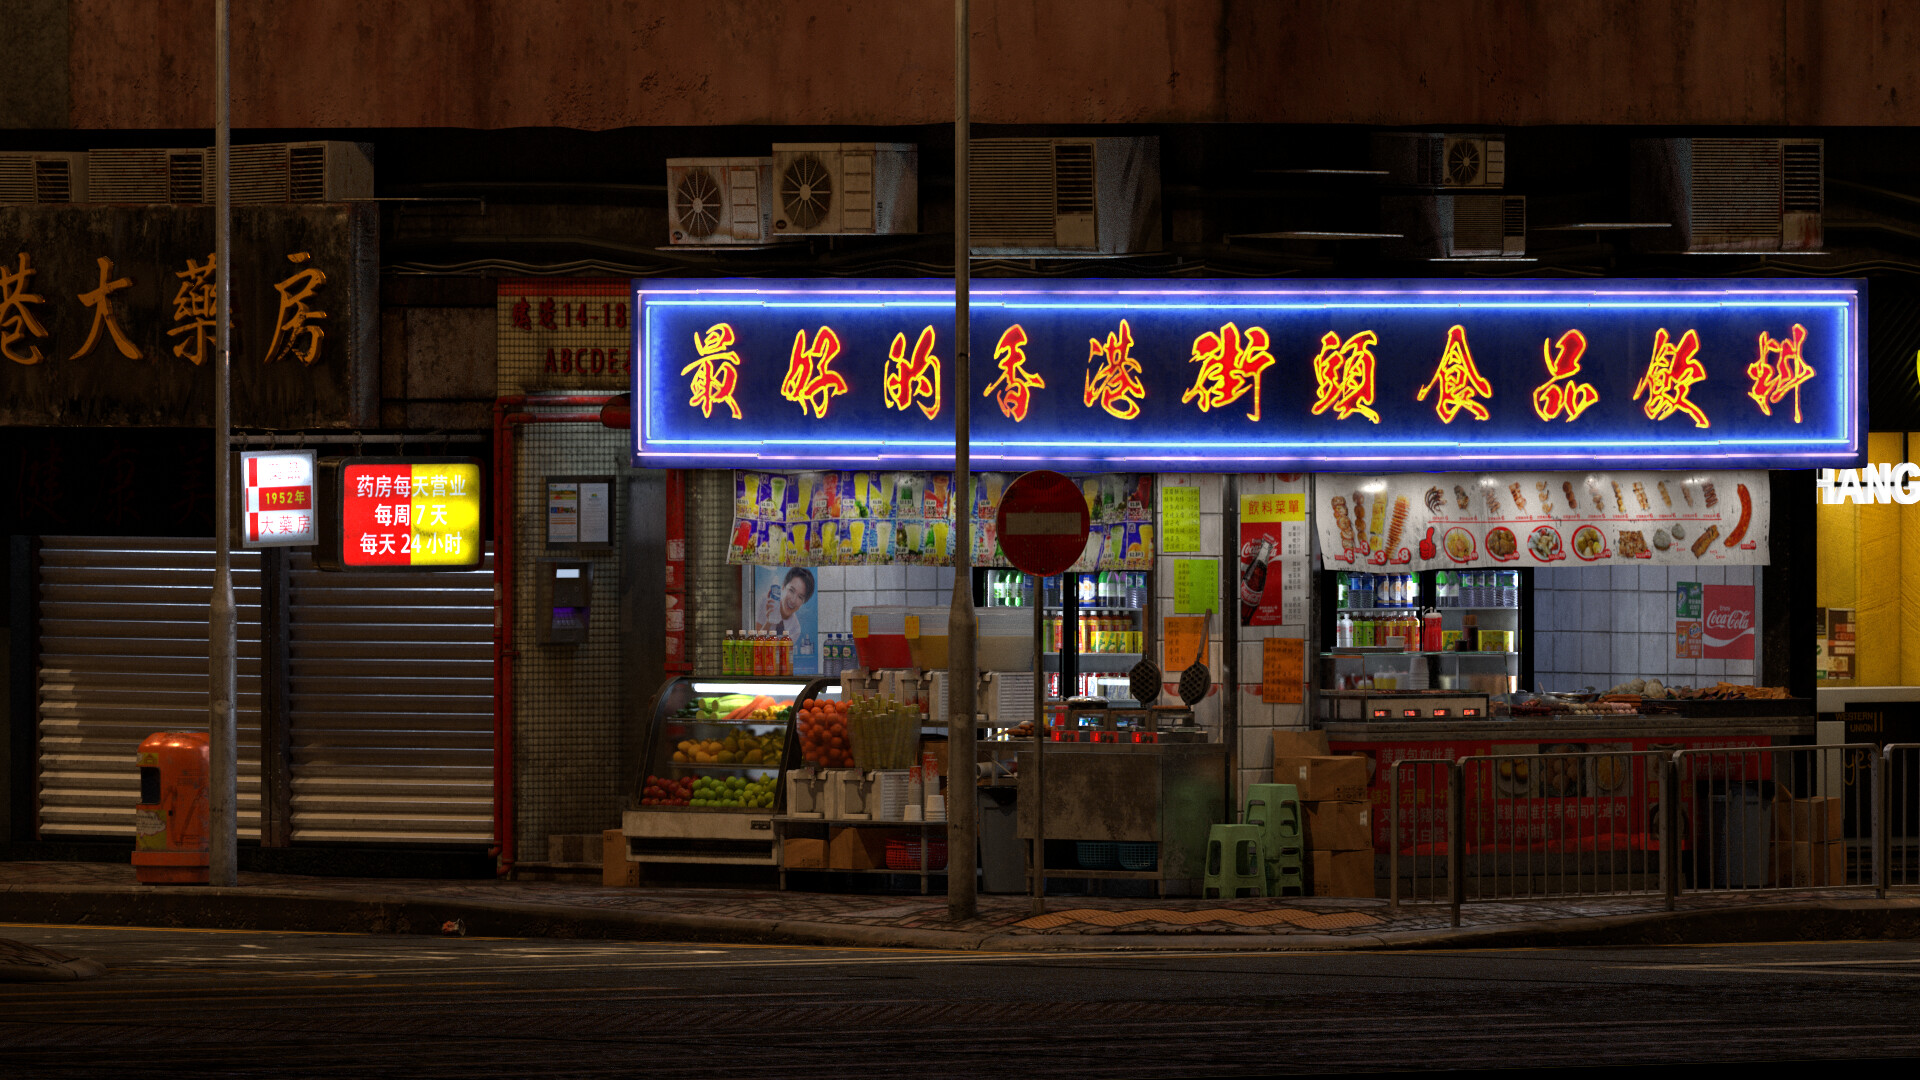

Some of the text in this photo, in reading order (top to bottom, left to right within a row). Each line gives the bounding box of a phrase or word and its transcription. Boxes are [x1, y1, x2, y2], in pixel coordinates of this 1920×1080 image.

[680, 318, 1815, 429] 最好的香港街頭食品飲料
[356, 474, 466, 498] 药房每天营业
[265, 489, 306, 505] 1952年
[1248, 499, 1299, 515] 飲料菜單
[260, 514, 311, 535] 大藥房
[1706, 610, 1751, 630] Coca-Cola
[1835, 711, 1873, 721] WESTERN
[1850, 722, 1873, 733] UNION
